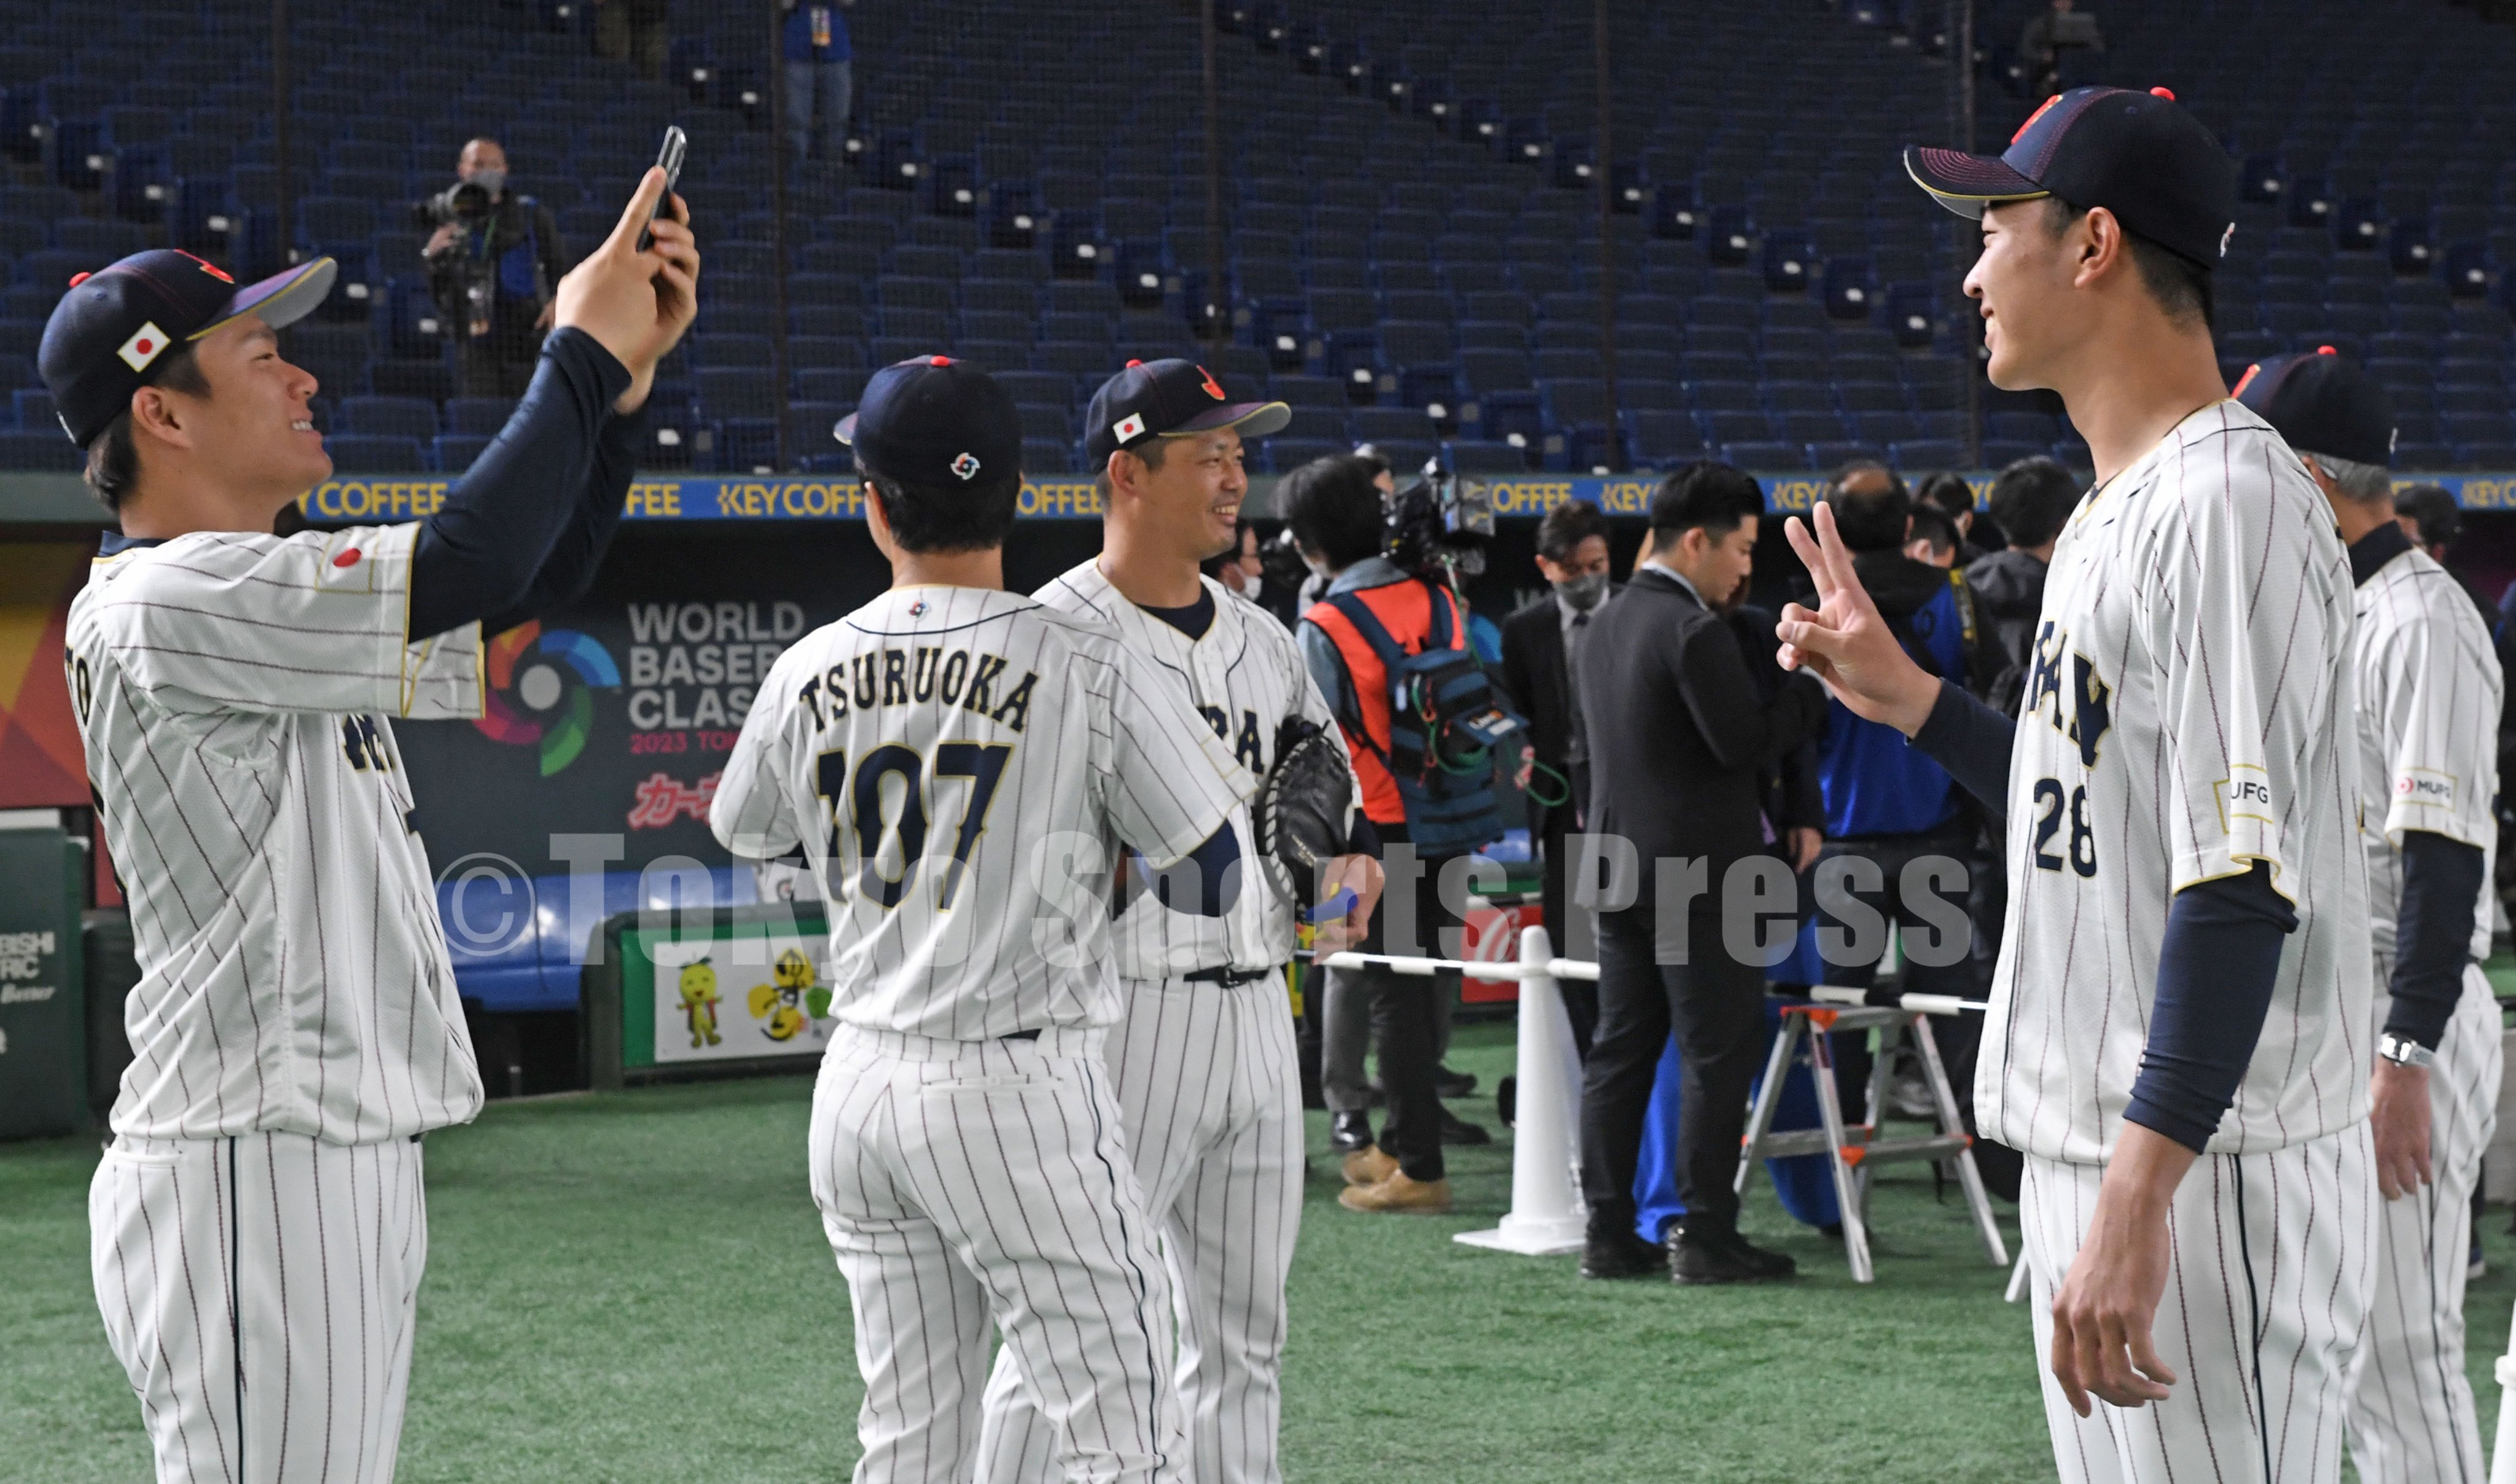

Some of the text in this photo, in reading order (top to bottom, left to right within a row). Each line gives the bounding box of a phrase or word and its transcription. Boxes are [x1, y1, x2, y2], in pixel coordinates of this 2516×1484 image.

[628, 601, 805, 644] WORLD
[799, 646, 1039, 734] TSURUOKA
[631, 732, 688, 755] 2023
[816, 740, 1017, 914] 107
[2033, 776, 2098, 878] 28
